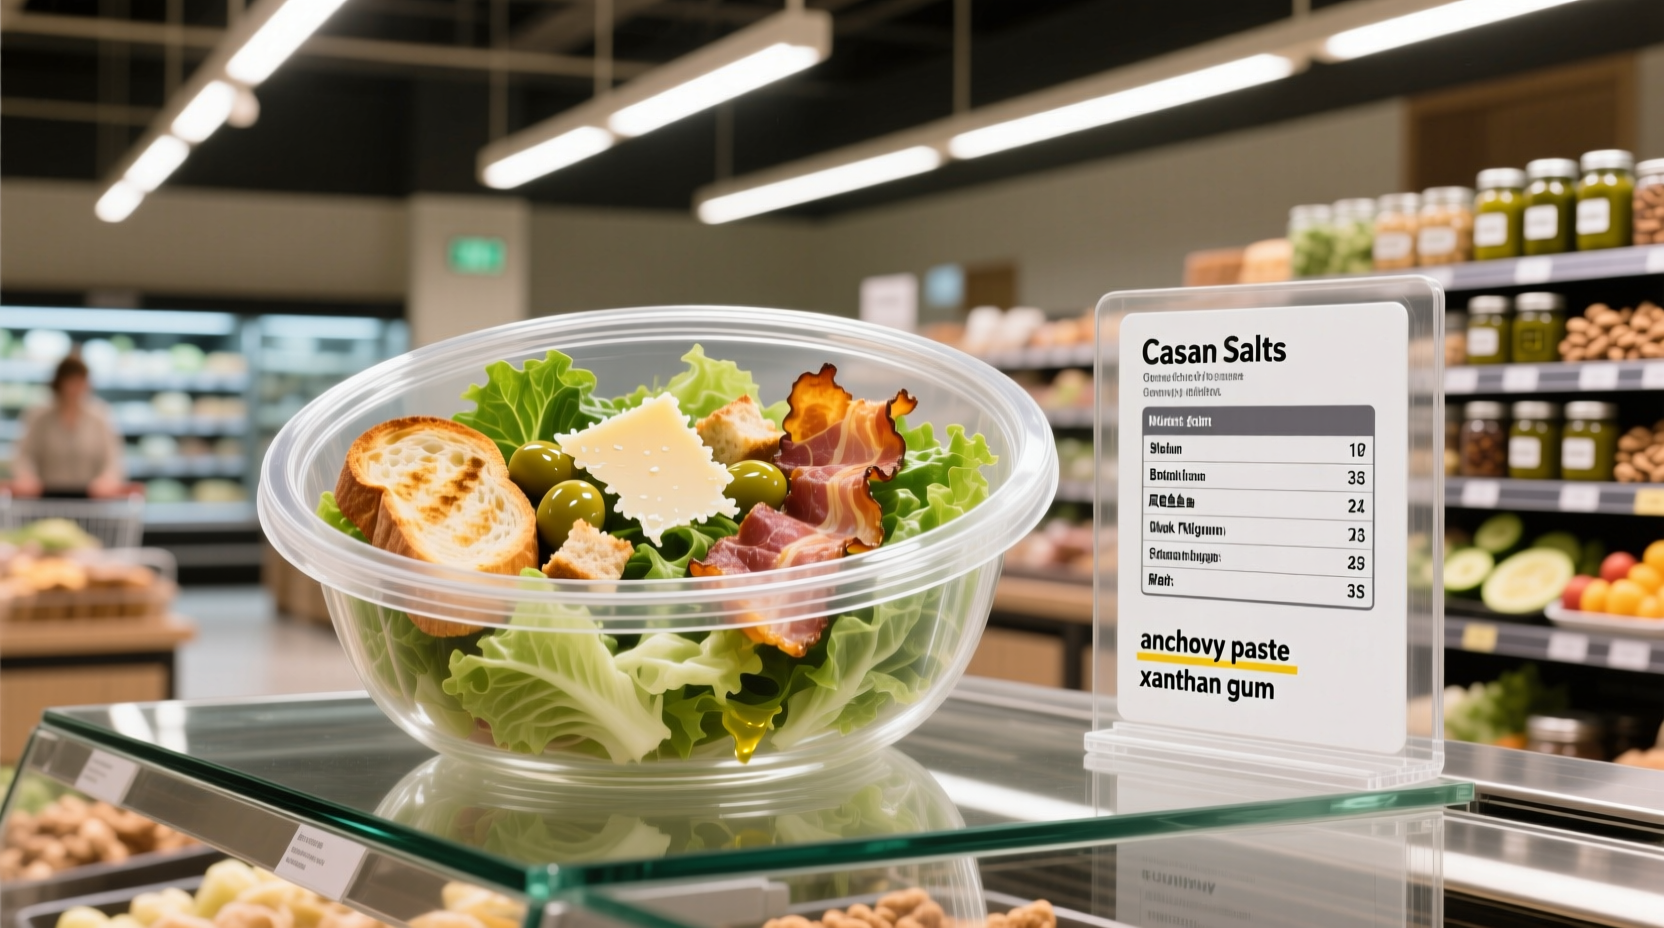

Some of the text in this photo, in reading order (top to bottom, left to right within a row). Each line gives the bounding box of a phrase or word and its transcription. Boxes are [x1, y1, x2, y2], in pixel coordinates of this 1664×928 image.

[1142, 334, 1287, 366] Casan Salts
[1140, 629, 1290, 665] anchovy paste
[1139, 668, 1275, 703] xanthan gum
